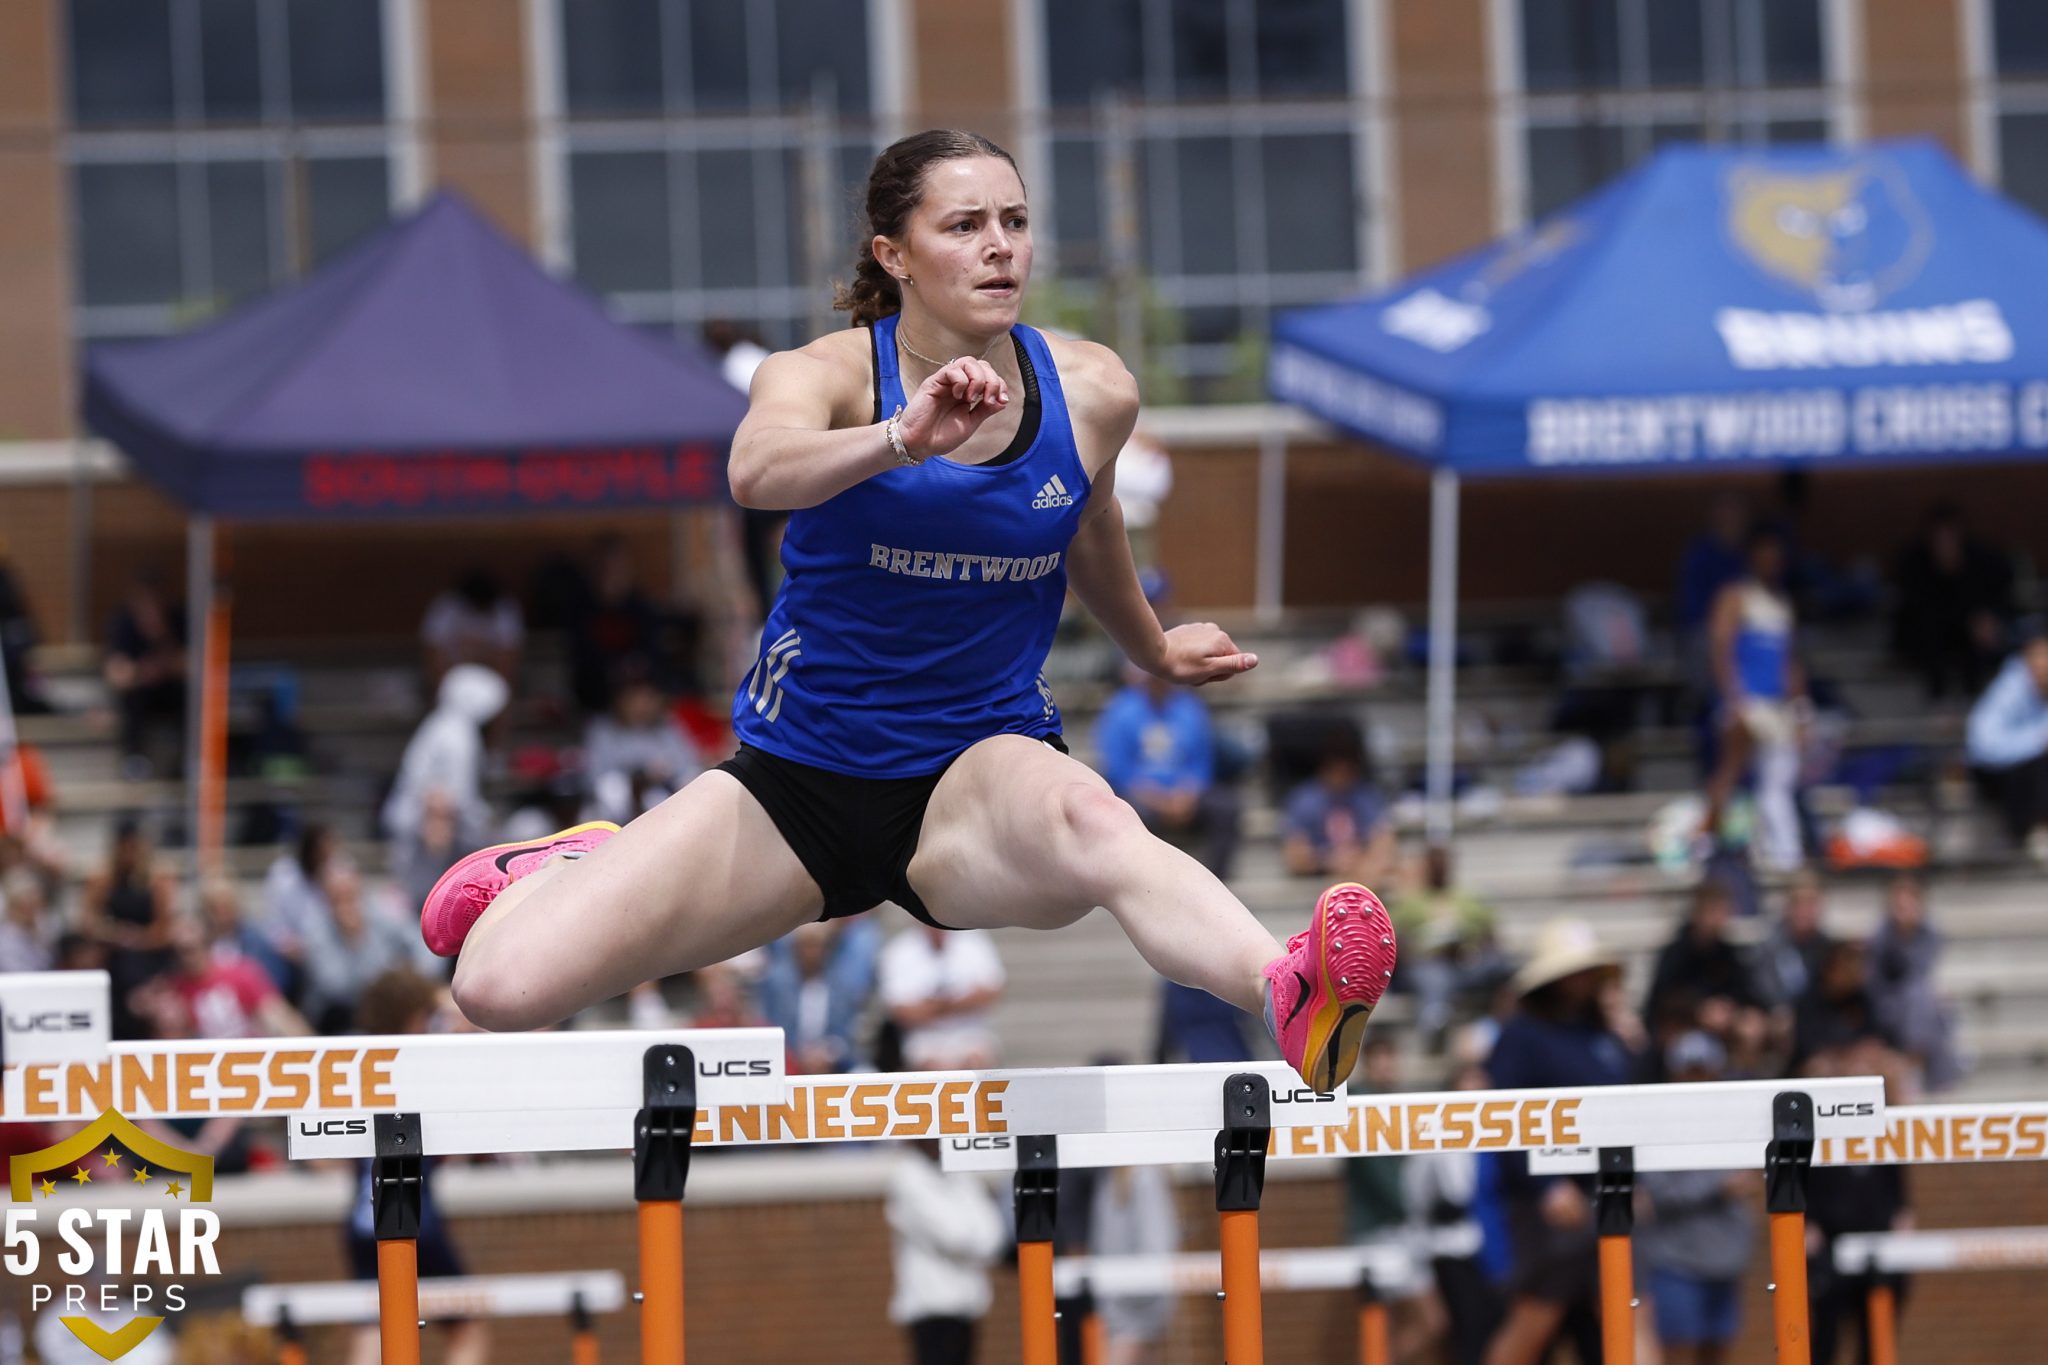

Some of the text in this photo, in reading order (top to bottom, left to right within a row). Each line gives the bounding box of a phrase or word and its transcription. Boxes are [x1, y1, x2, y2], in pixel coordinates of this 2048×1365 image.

[1716, 301, 2012, 369] BRUINS
[1527, 391, 1844, 466] BRENTWOOD
[1854, 384, 2010, 458] CROSS
[1032, 494, 1073, 510] adidas
[869, 543, 1061, 582] BRENTWOOD
[6, 1011, 92, 1033] UCS
[700, 1060, 771, 1077] UCS
[1272, 1089, 1336, 1104] UCS
[1817, 1103, 1875, 1117] UCS
[300, 1120, 367, 1137] UCS
[953, 1136, 1010, 1150] UCS
